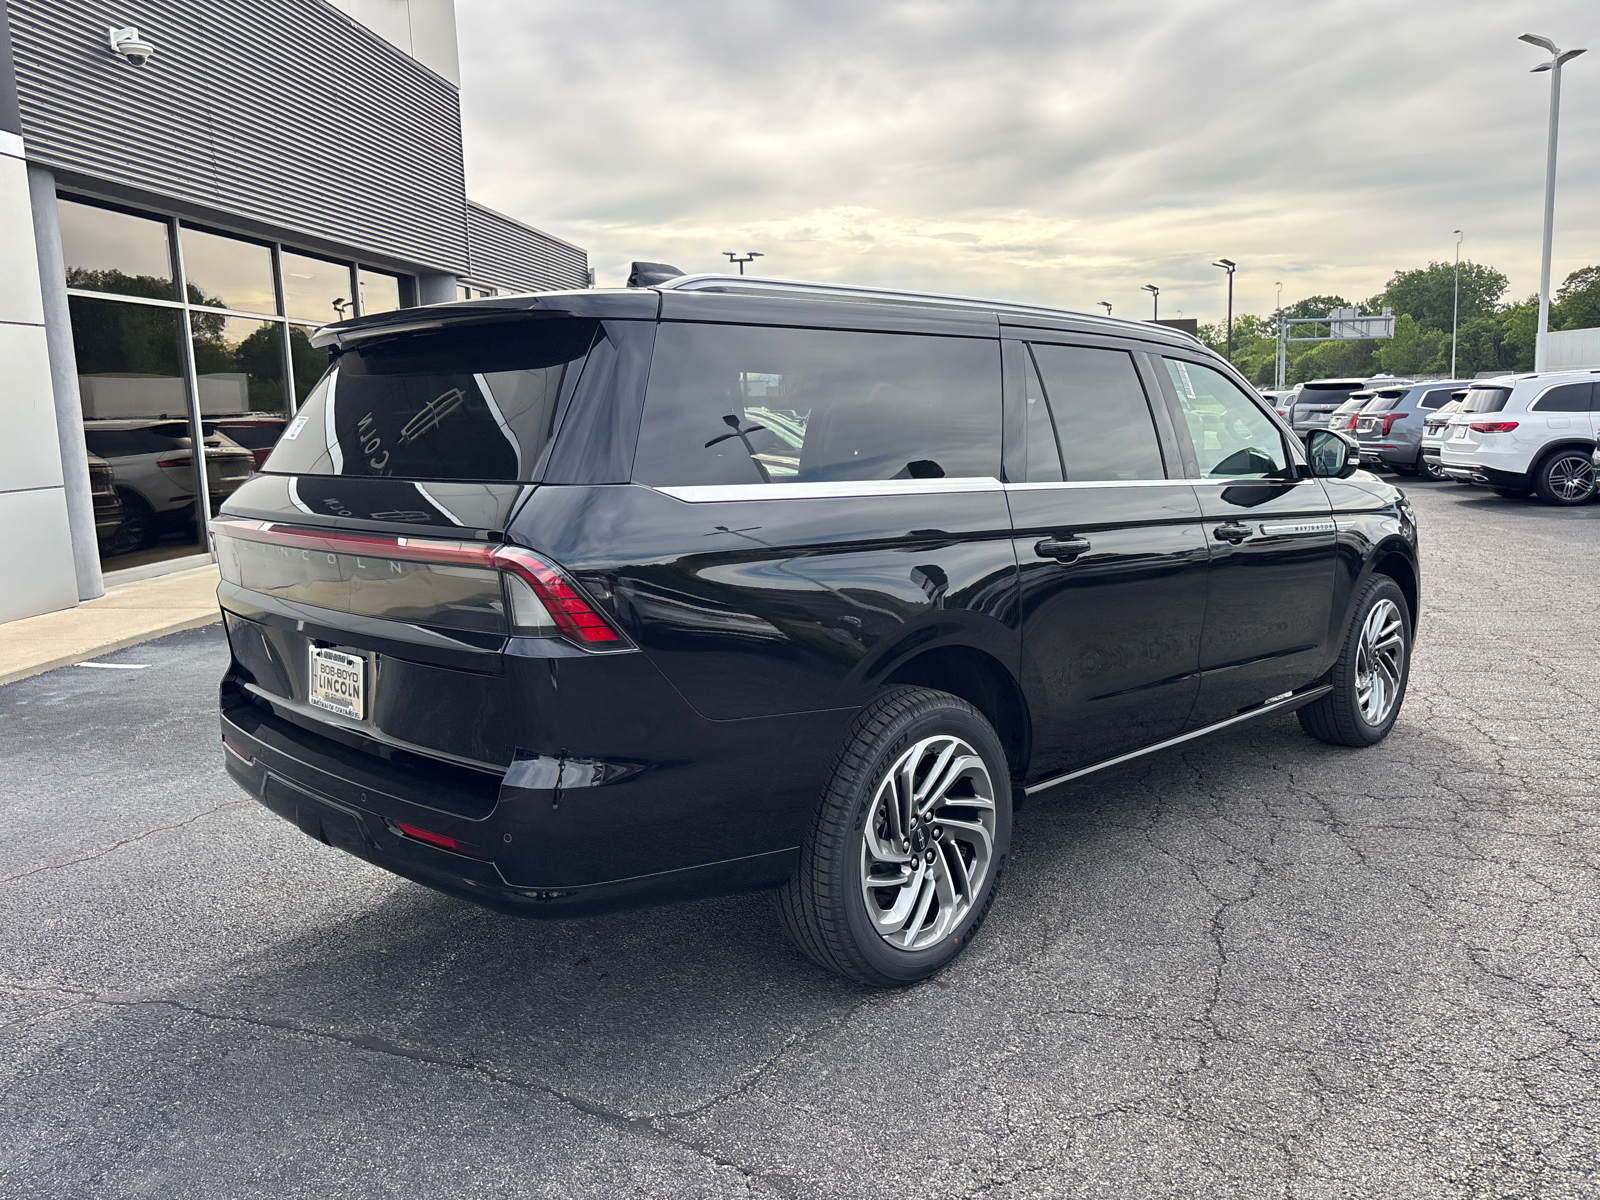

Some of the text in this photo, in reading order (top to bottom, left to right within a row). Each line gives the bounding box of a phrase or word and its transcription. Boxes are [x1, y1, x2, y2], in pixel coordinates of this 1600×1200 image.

[1294, 524, 1333, 532] NAVIGATOR
[320, 663, 359, 683] BOB-BOYD
[319, 674, 360, 700] LINCOLN
